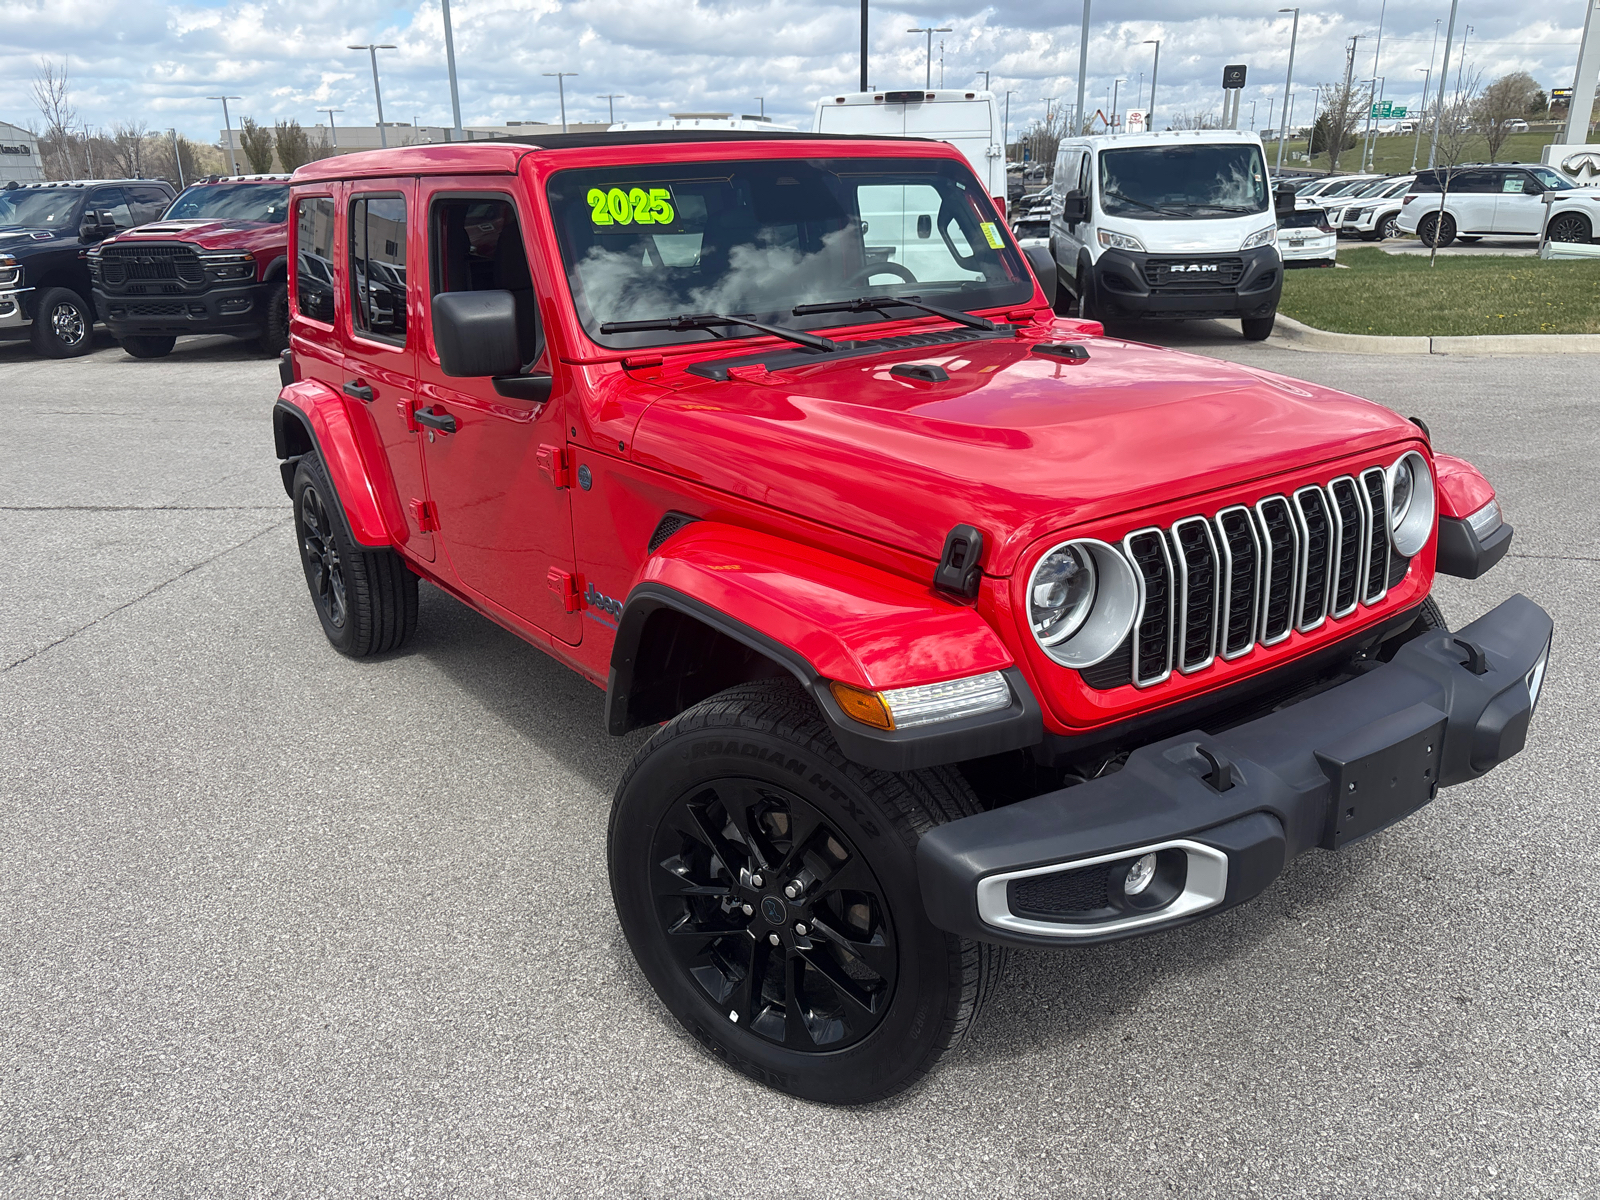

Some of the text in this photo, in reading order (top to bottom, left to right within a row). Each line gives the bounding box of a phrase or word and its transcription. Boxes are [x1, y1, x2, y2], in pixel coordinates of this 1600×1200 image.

[586, 187, 675, 226] 2025
[1170, 264, 1218, 272] RAM
[583, 581, 624, 623] Jeep
[690, 740, 808, 777] ROADIAN
